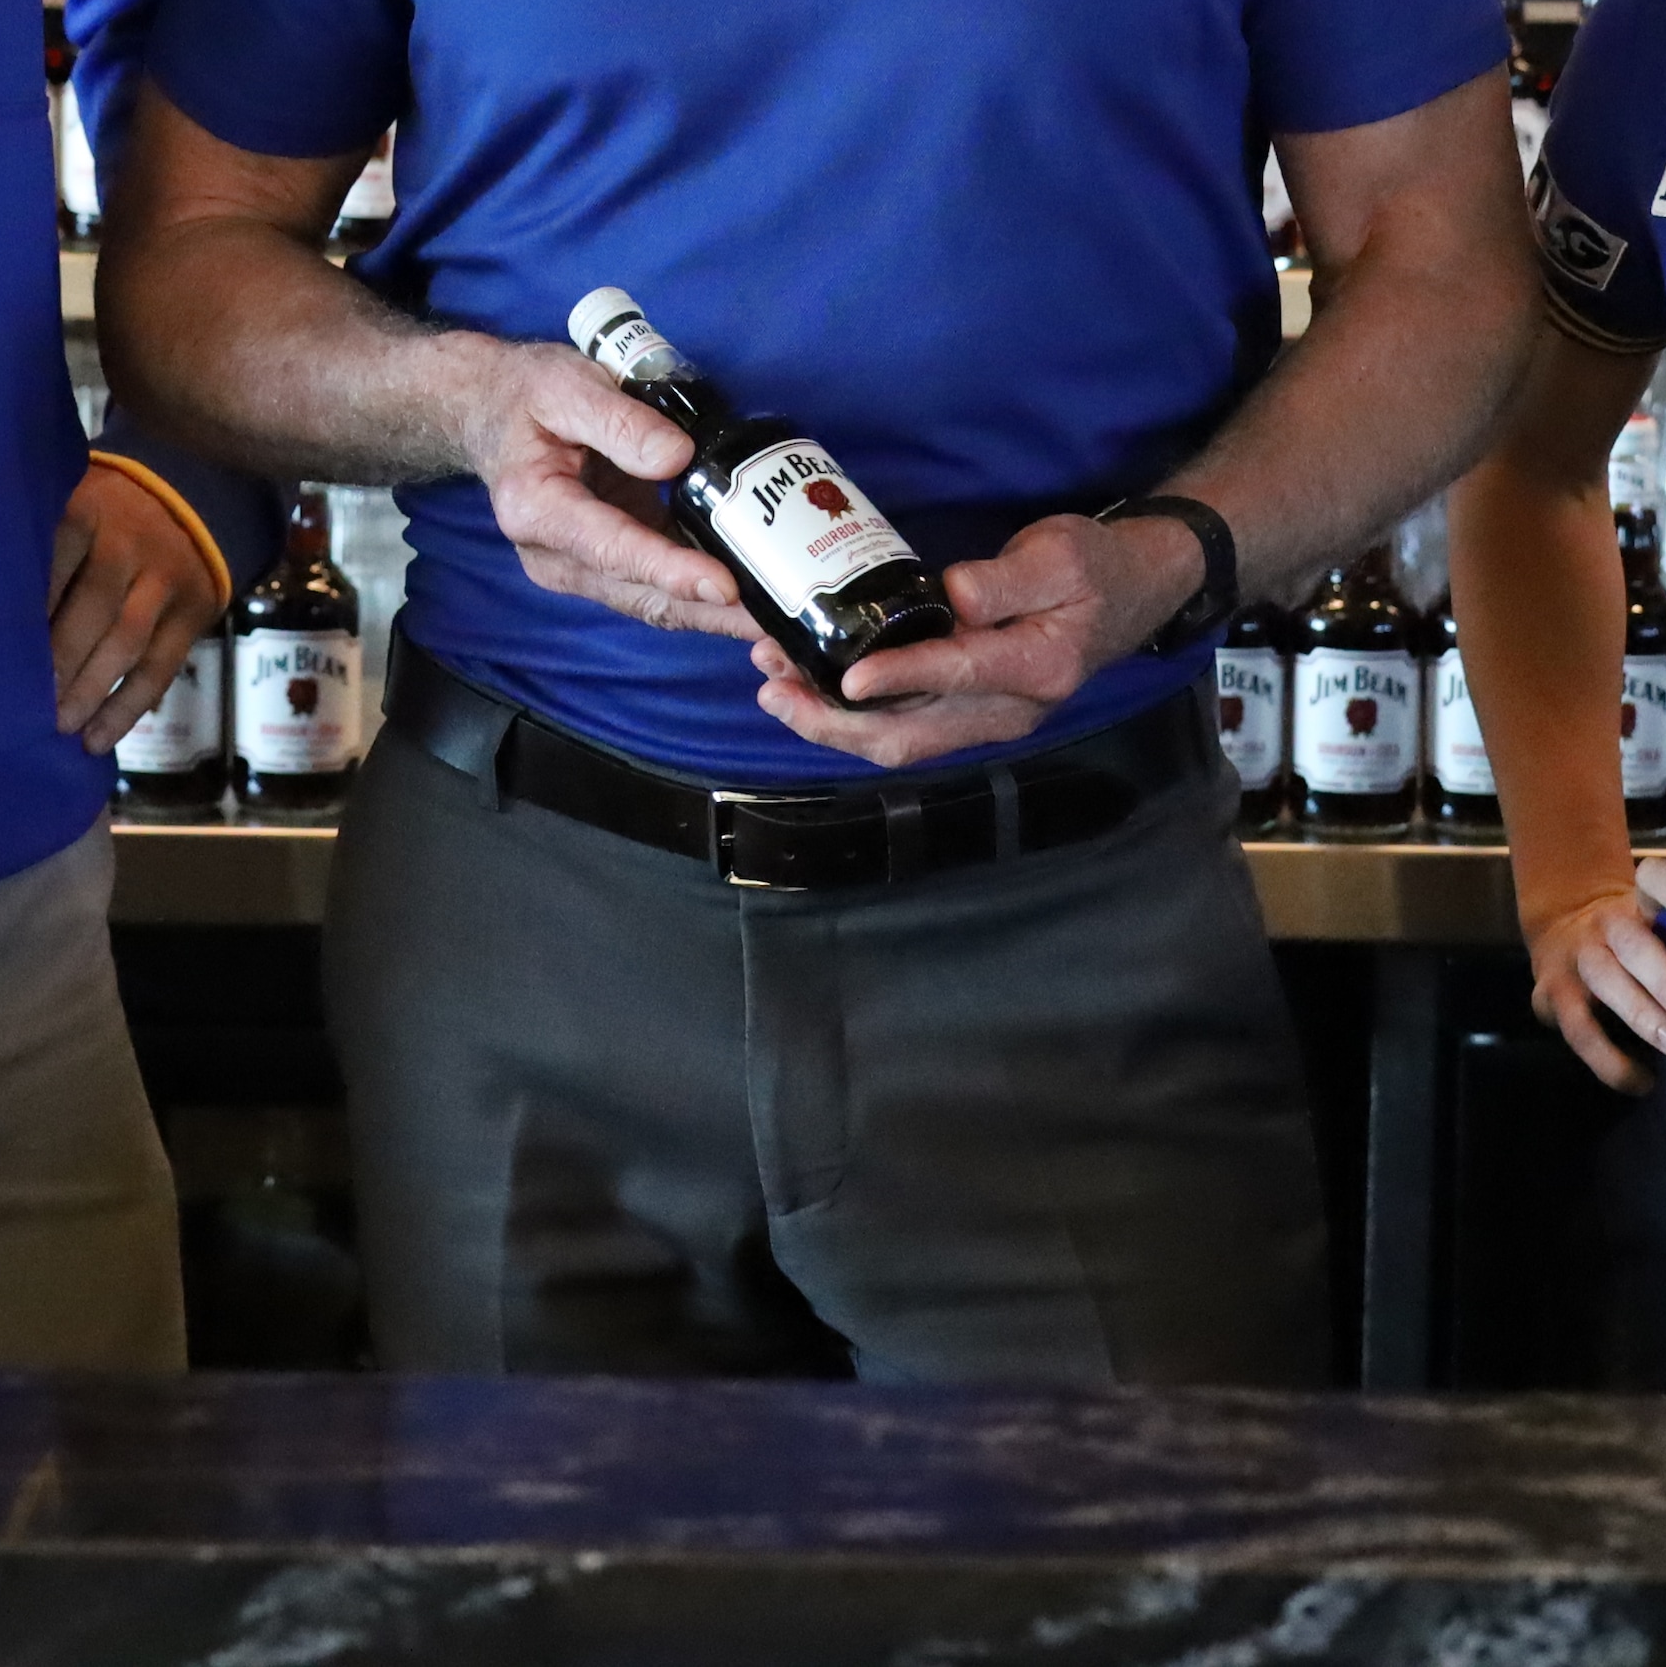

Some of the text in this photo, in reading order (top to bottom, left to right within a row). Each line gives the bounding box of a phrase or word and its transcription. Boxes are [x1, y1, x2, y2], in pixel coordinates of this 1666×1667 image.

[615, 331, 635, 361] JIM
[752, 453, 845, 526] JIM BEA
[806, 520, 864, 558] BOURBON
[251, 651, 289, 686] JIM
[1310, 665, 1407, 706] JIM BEAM
[1442, 673, 1464, 707] JI
